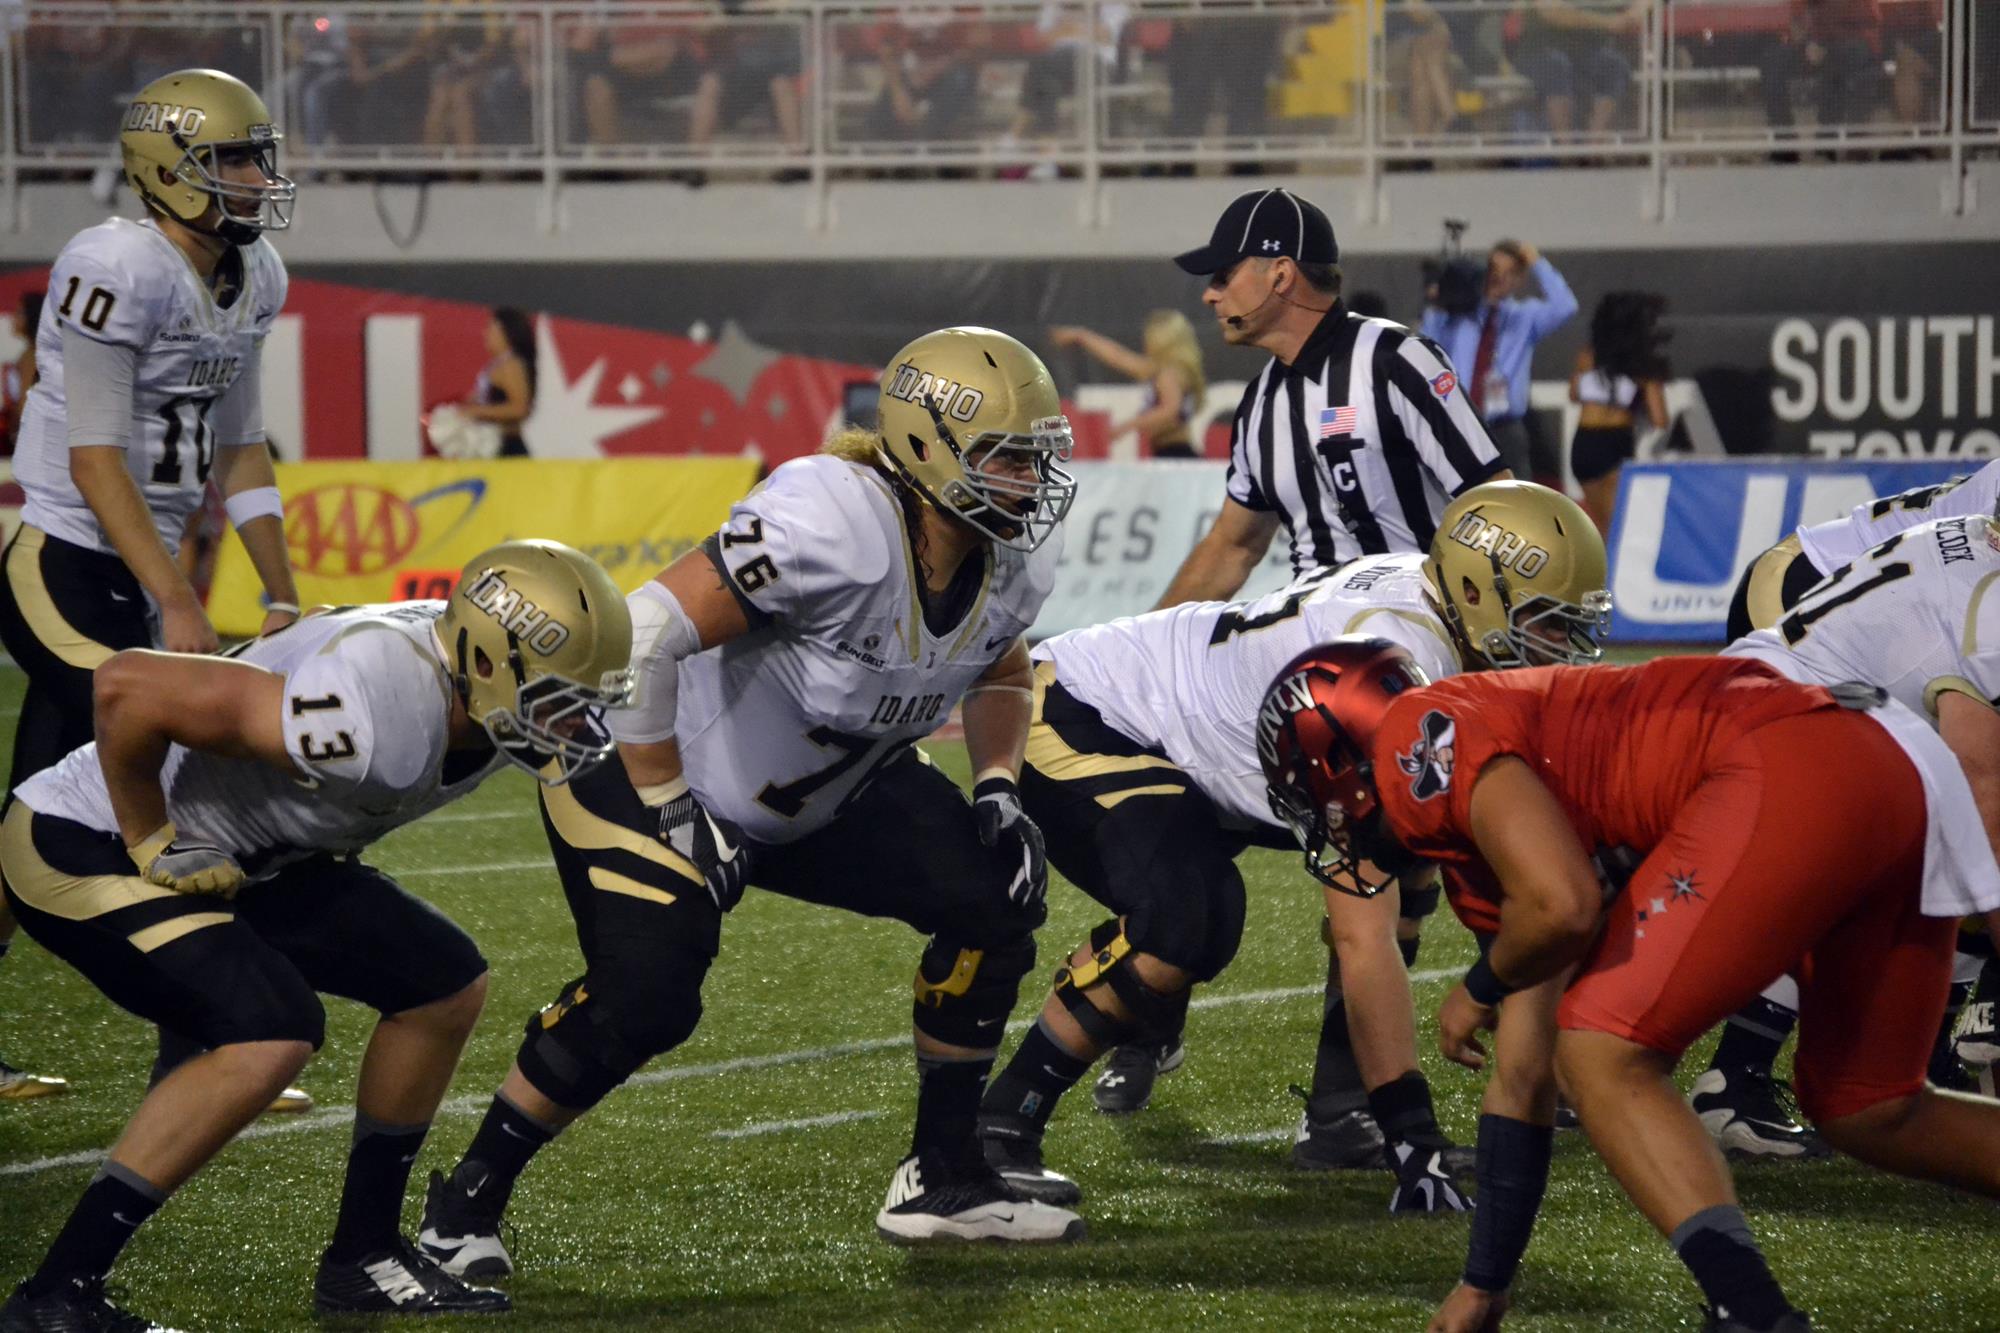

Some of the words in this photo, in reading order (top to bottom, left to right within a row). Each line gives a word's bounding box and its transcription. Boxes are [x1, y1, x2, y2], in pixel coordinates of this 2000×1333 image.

[59, 276, 116, 331] 10
[886, 363, 984, 423] IDAHO
[1332, 461, 1356, 492] C
[723, 518, 780, 594] 76
[1449, 511, 1549, 580] IDAHO
[463, 567, 571, 657] IDAHO
[291, 692, 358, 765] 13
[869, 693, 945, 725] IDAHO
[363, 1256, 427, 1306] NIKE
